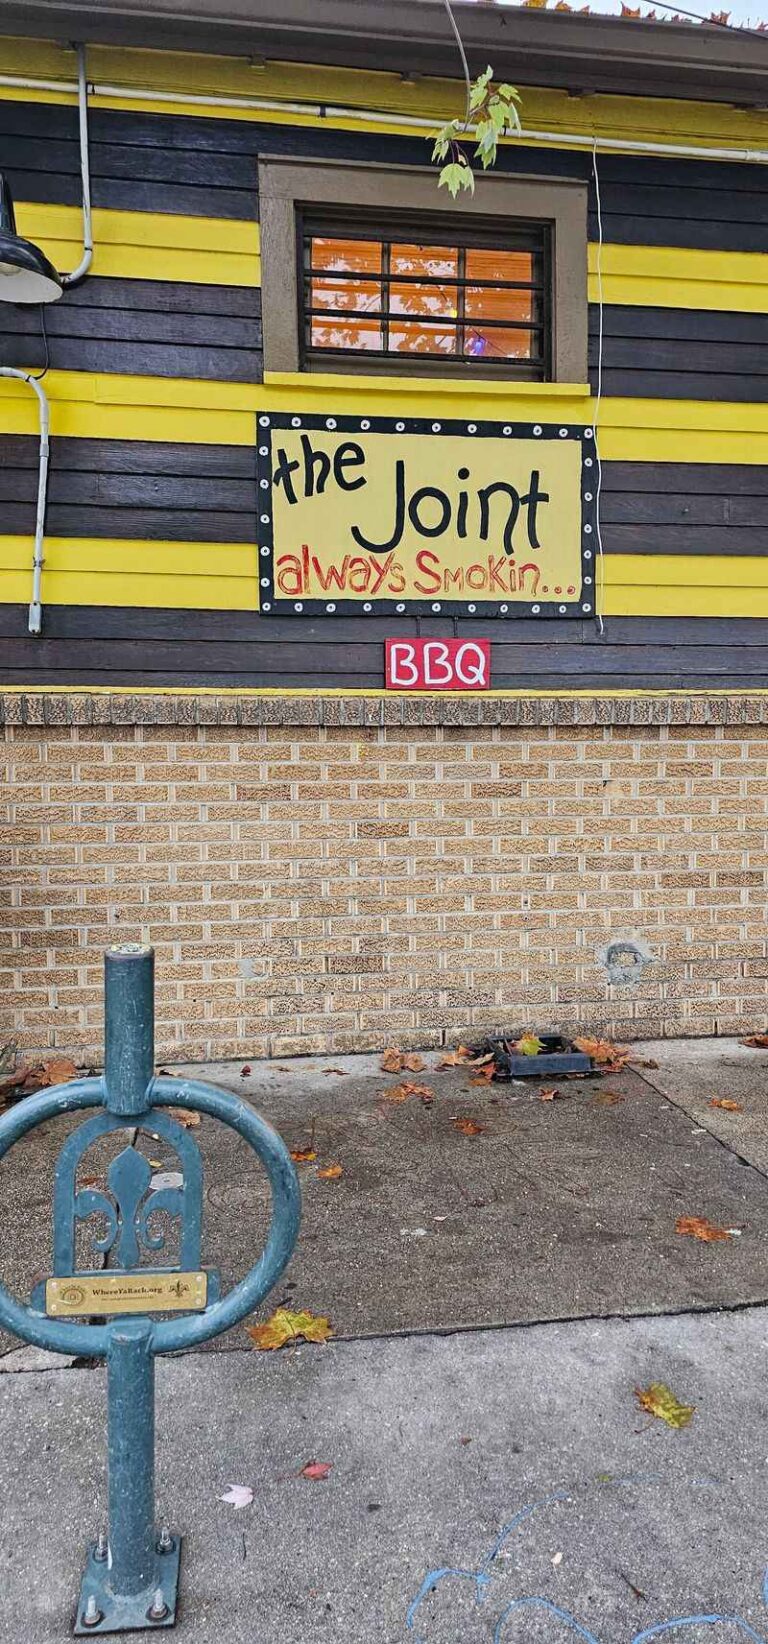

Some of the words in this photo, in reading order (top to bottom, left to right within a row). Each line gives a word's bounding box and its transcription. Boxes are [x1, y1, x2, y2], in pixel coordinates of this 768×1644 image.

[273, 434, 367, 504] the
[350, 460, 549, 555] Joint
[276, 545, 406, 595] always
[390, 642, 486, 686] BBQ
[92, 1286, 163, 1296] WhereYaRack.org
